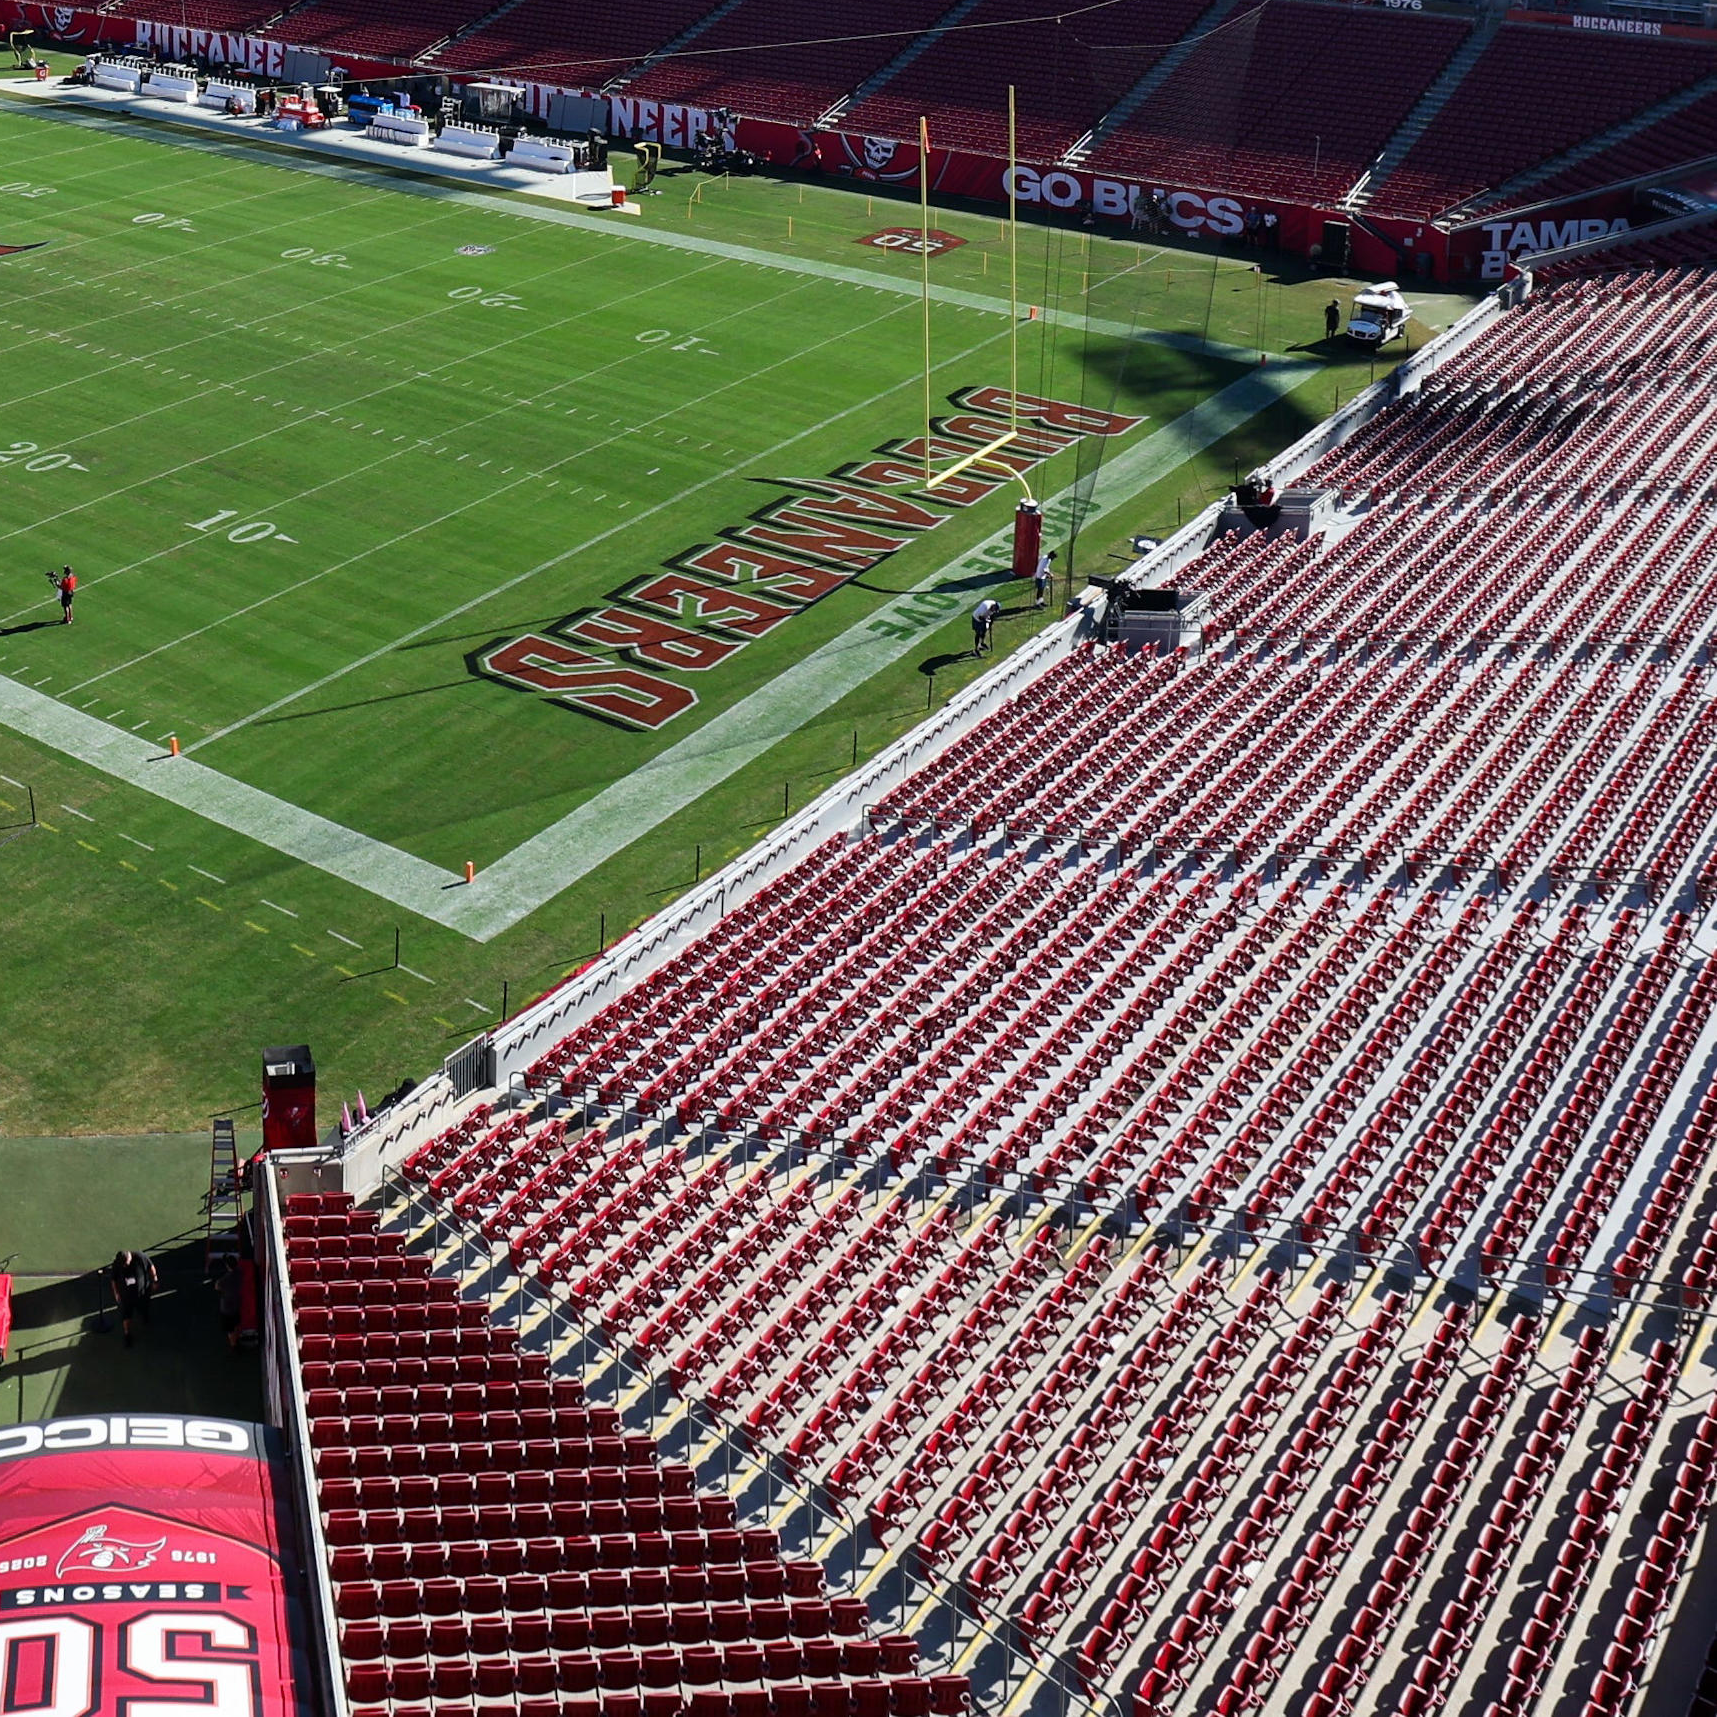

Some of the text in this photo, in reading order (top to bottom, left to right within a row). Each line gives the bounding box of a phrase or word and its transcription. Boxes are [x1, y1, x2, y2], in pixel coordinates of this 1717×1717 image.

[1572, 14, 1662, 35] BUCCANEERS
[1002, 165, 1082, 209] GO
[872, 234, 944, 253] 50
[280, 245, 342, 268] 30
[447, 286, 523, 307] 20
[635, 329, 710, 351] 10
[184, 509, 277, 544] 10
[482, 385, 1151, 731] BUCCANEERS
[171, 1549, 217, 1564] 1976
[15, 1582, 205, 1606] SEASONS
